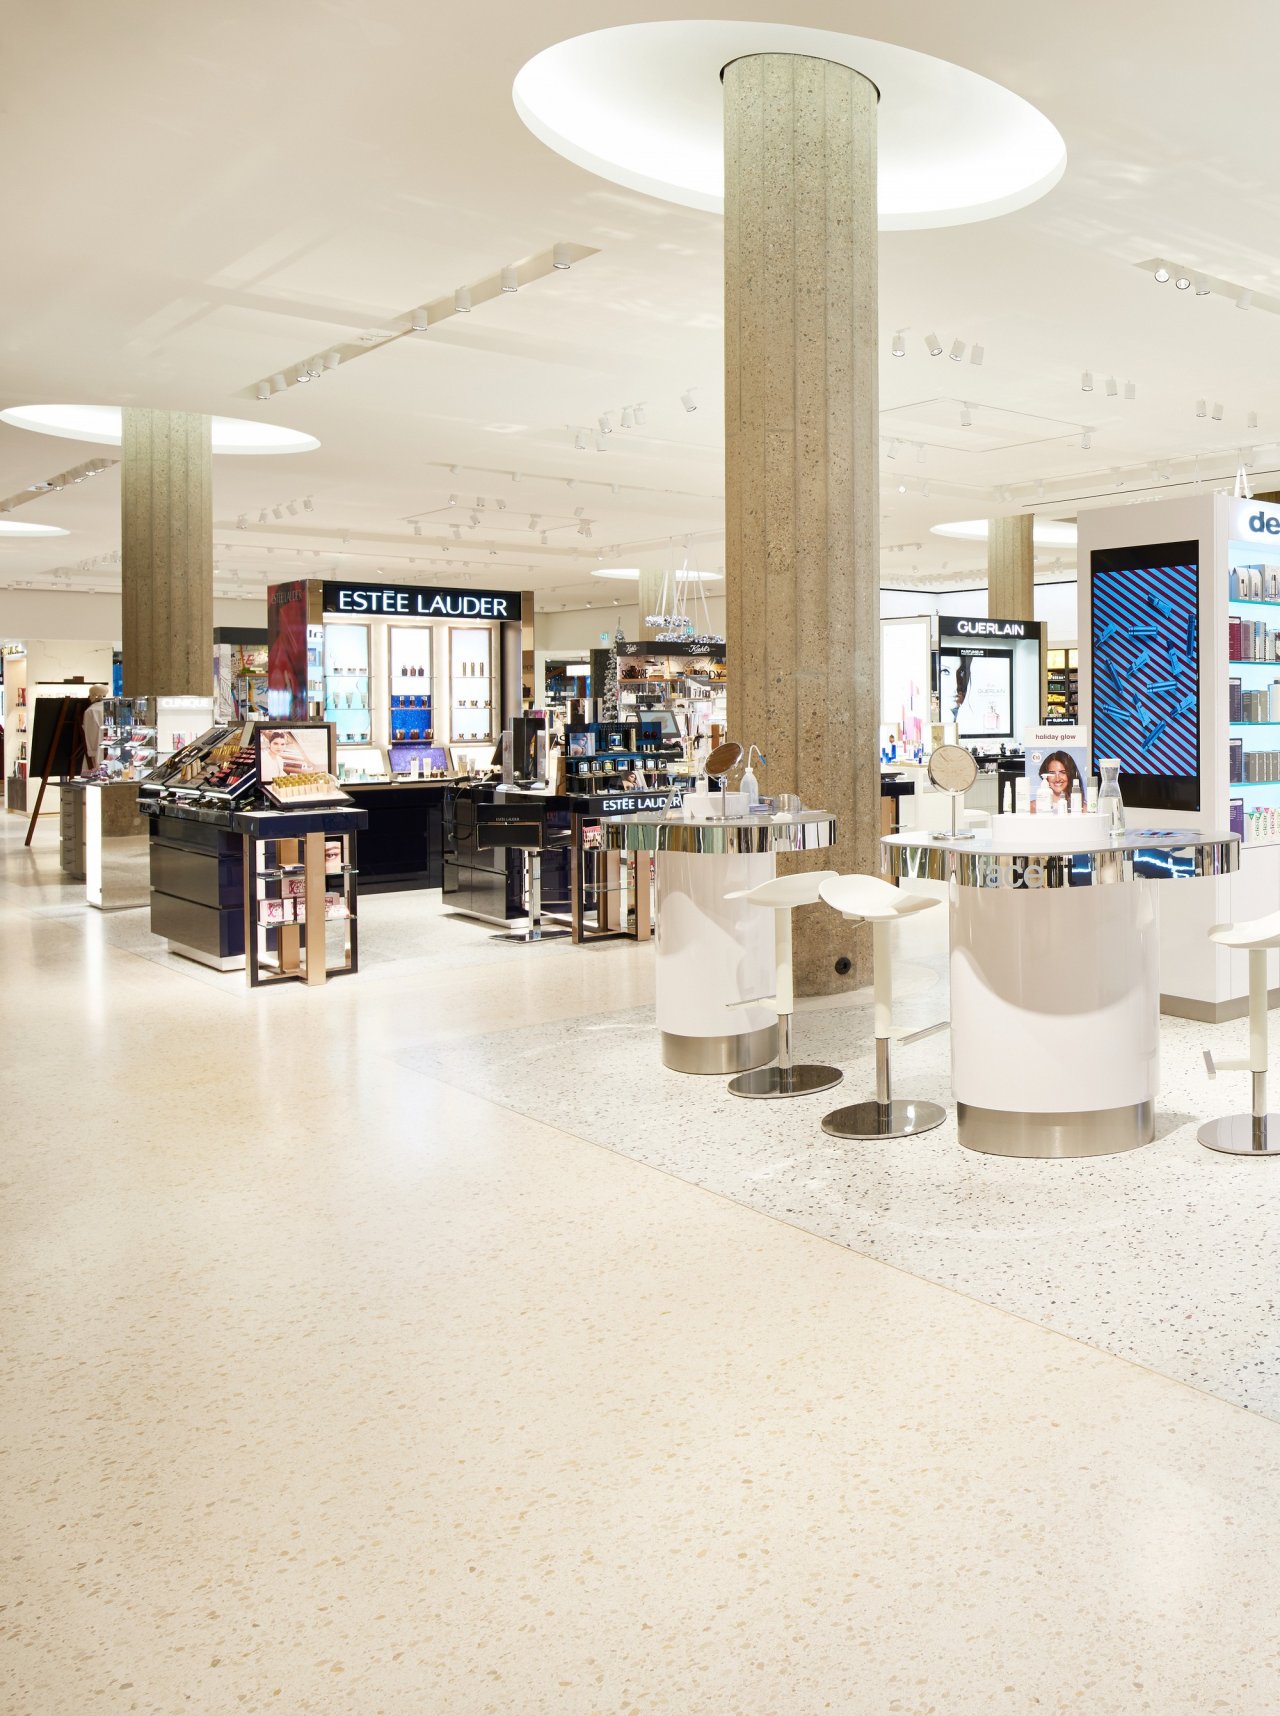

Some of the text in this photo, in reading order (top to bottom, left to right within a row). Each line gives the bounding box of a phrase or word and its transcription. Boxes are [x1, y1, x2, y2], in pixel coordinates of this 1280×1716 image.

[417, 594, 508, 616] LAUDER
[957, 620, 1024, 636] GUERLAIN
[688, 644, 711, 655] Kiehl's
